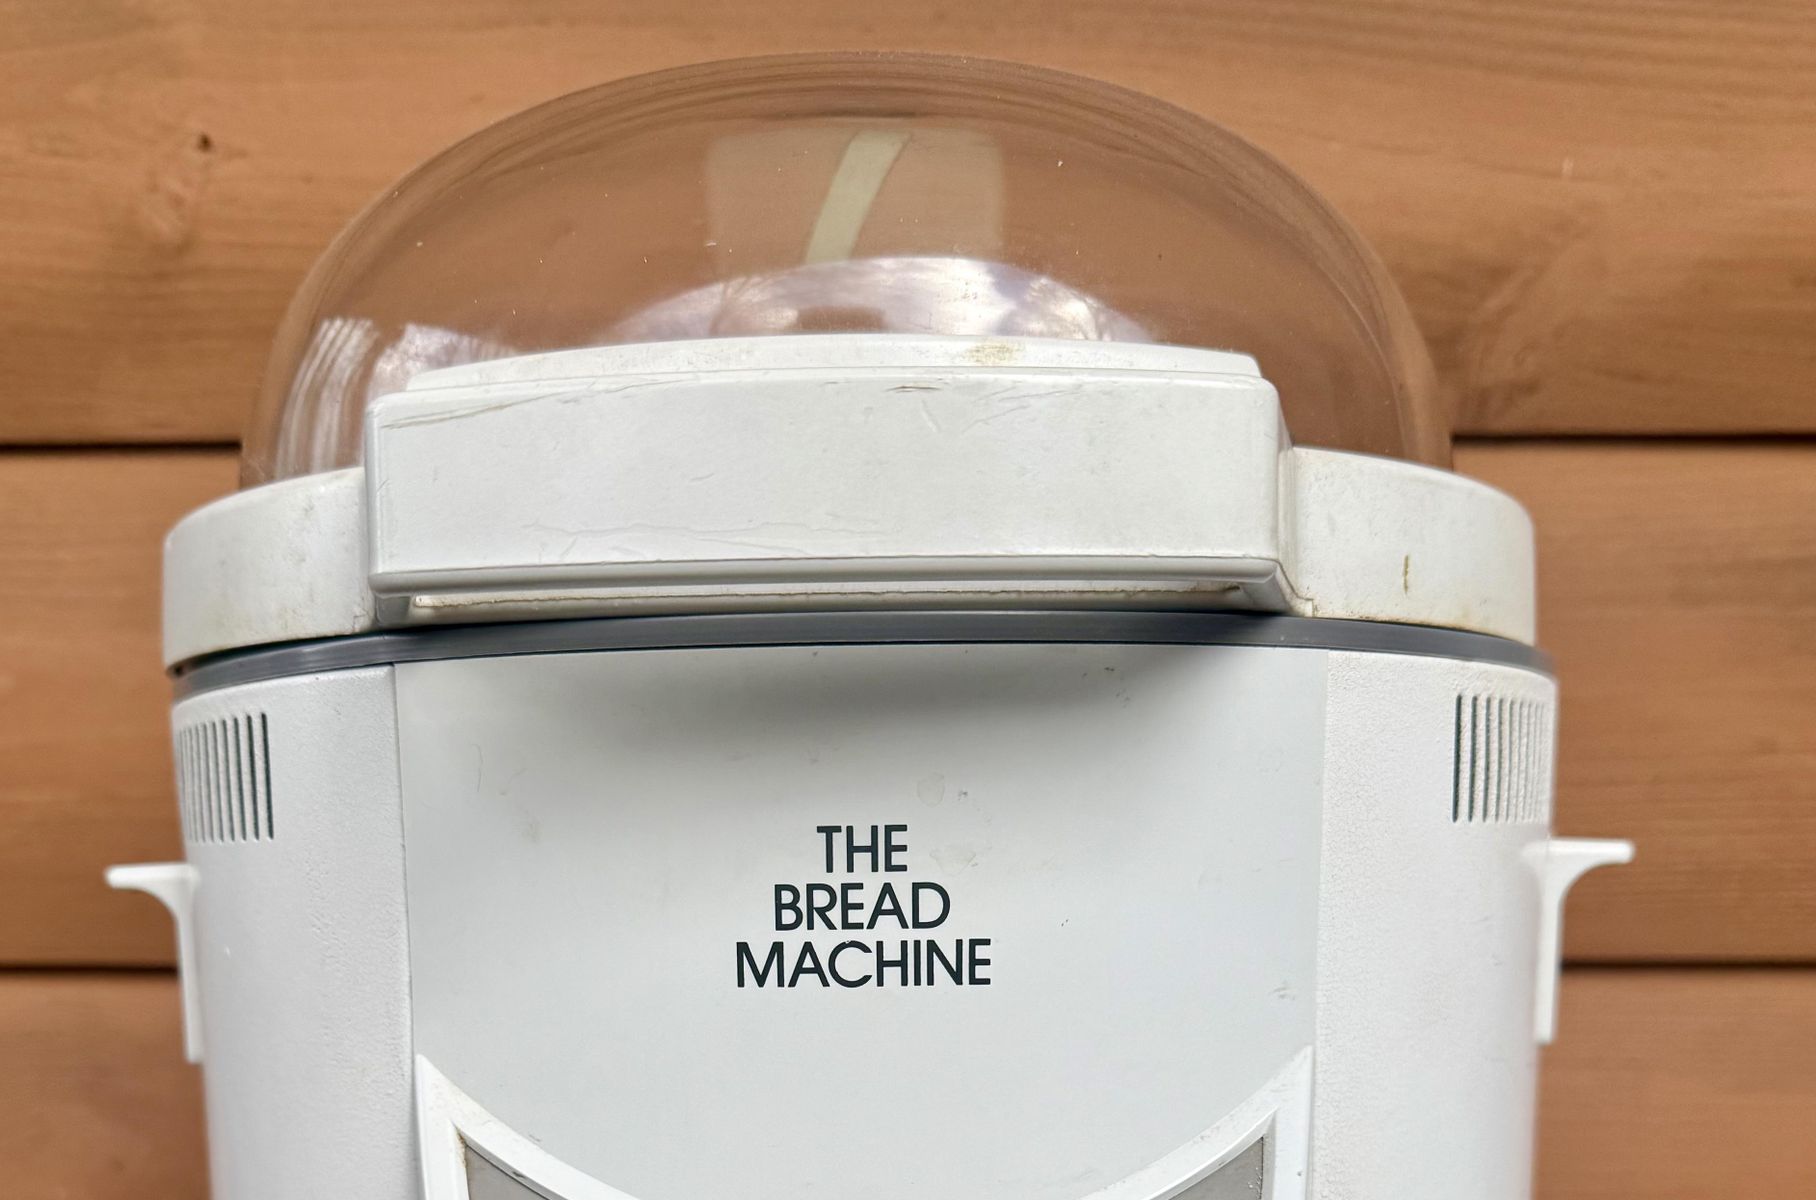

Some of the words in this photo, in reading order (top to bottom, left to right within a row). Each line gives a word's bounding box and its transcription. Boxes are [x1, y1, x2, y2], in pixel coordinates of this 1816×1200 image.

[817, 824, 908, 873] THE
[774, 882, 951, 931] BREAD
[736, 938, 991, 988] MACHINE
